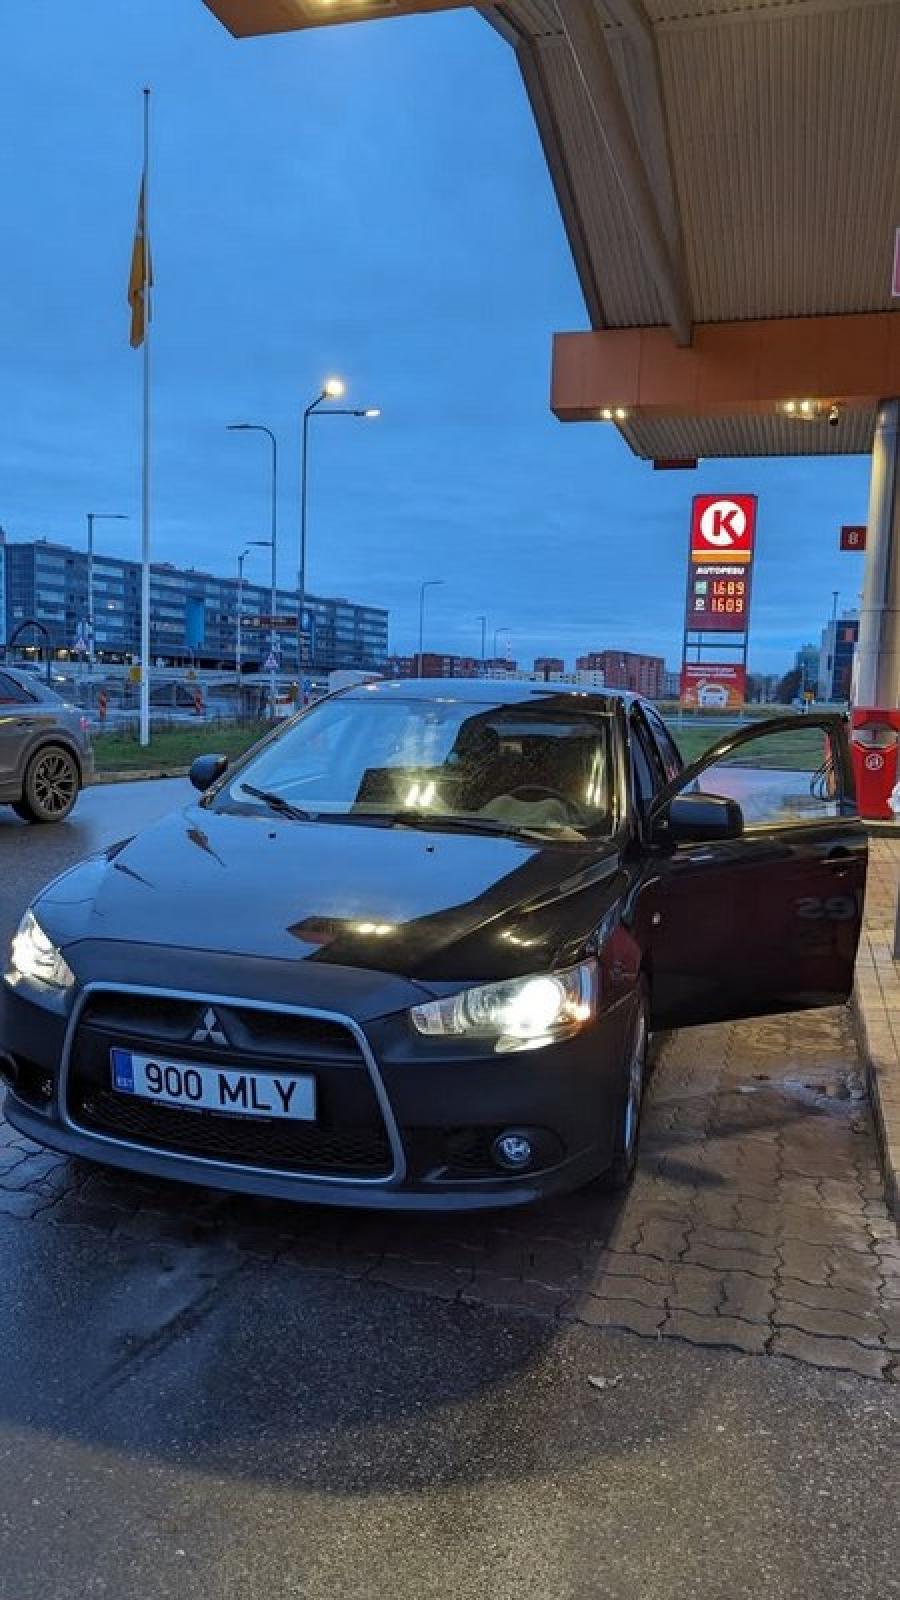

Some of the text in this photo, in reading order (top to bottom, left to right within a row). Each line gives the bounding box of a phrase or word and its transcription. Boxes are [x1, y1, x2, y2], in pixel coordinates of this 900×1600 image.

[711, 509, 743, 544] K
[848, 531, 859, 545] 8
[145, 1062, 297, 1112] 900 MLY
